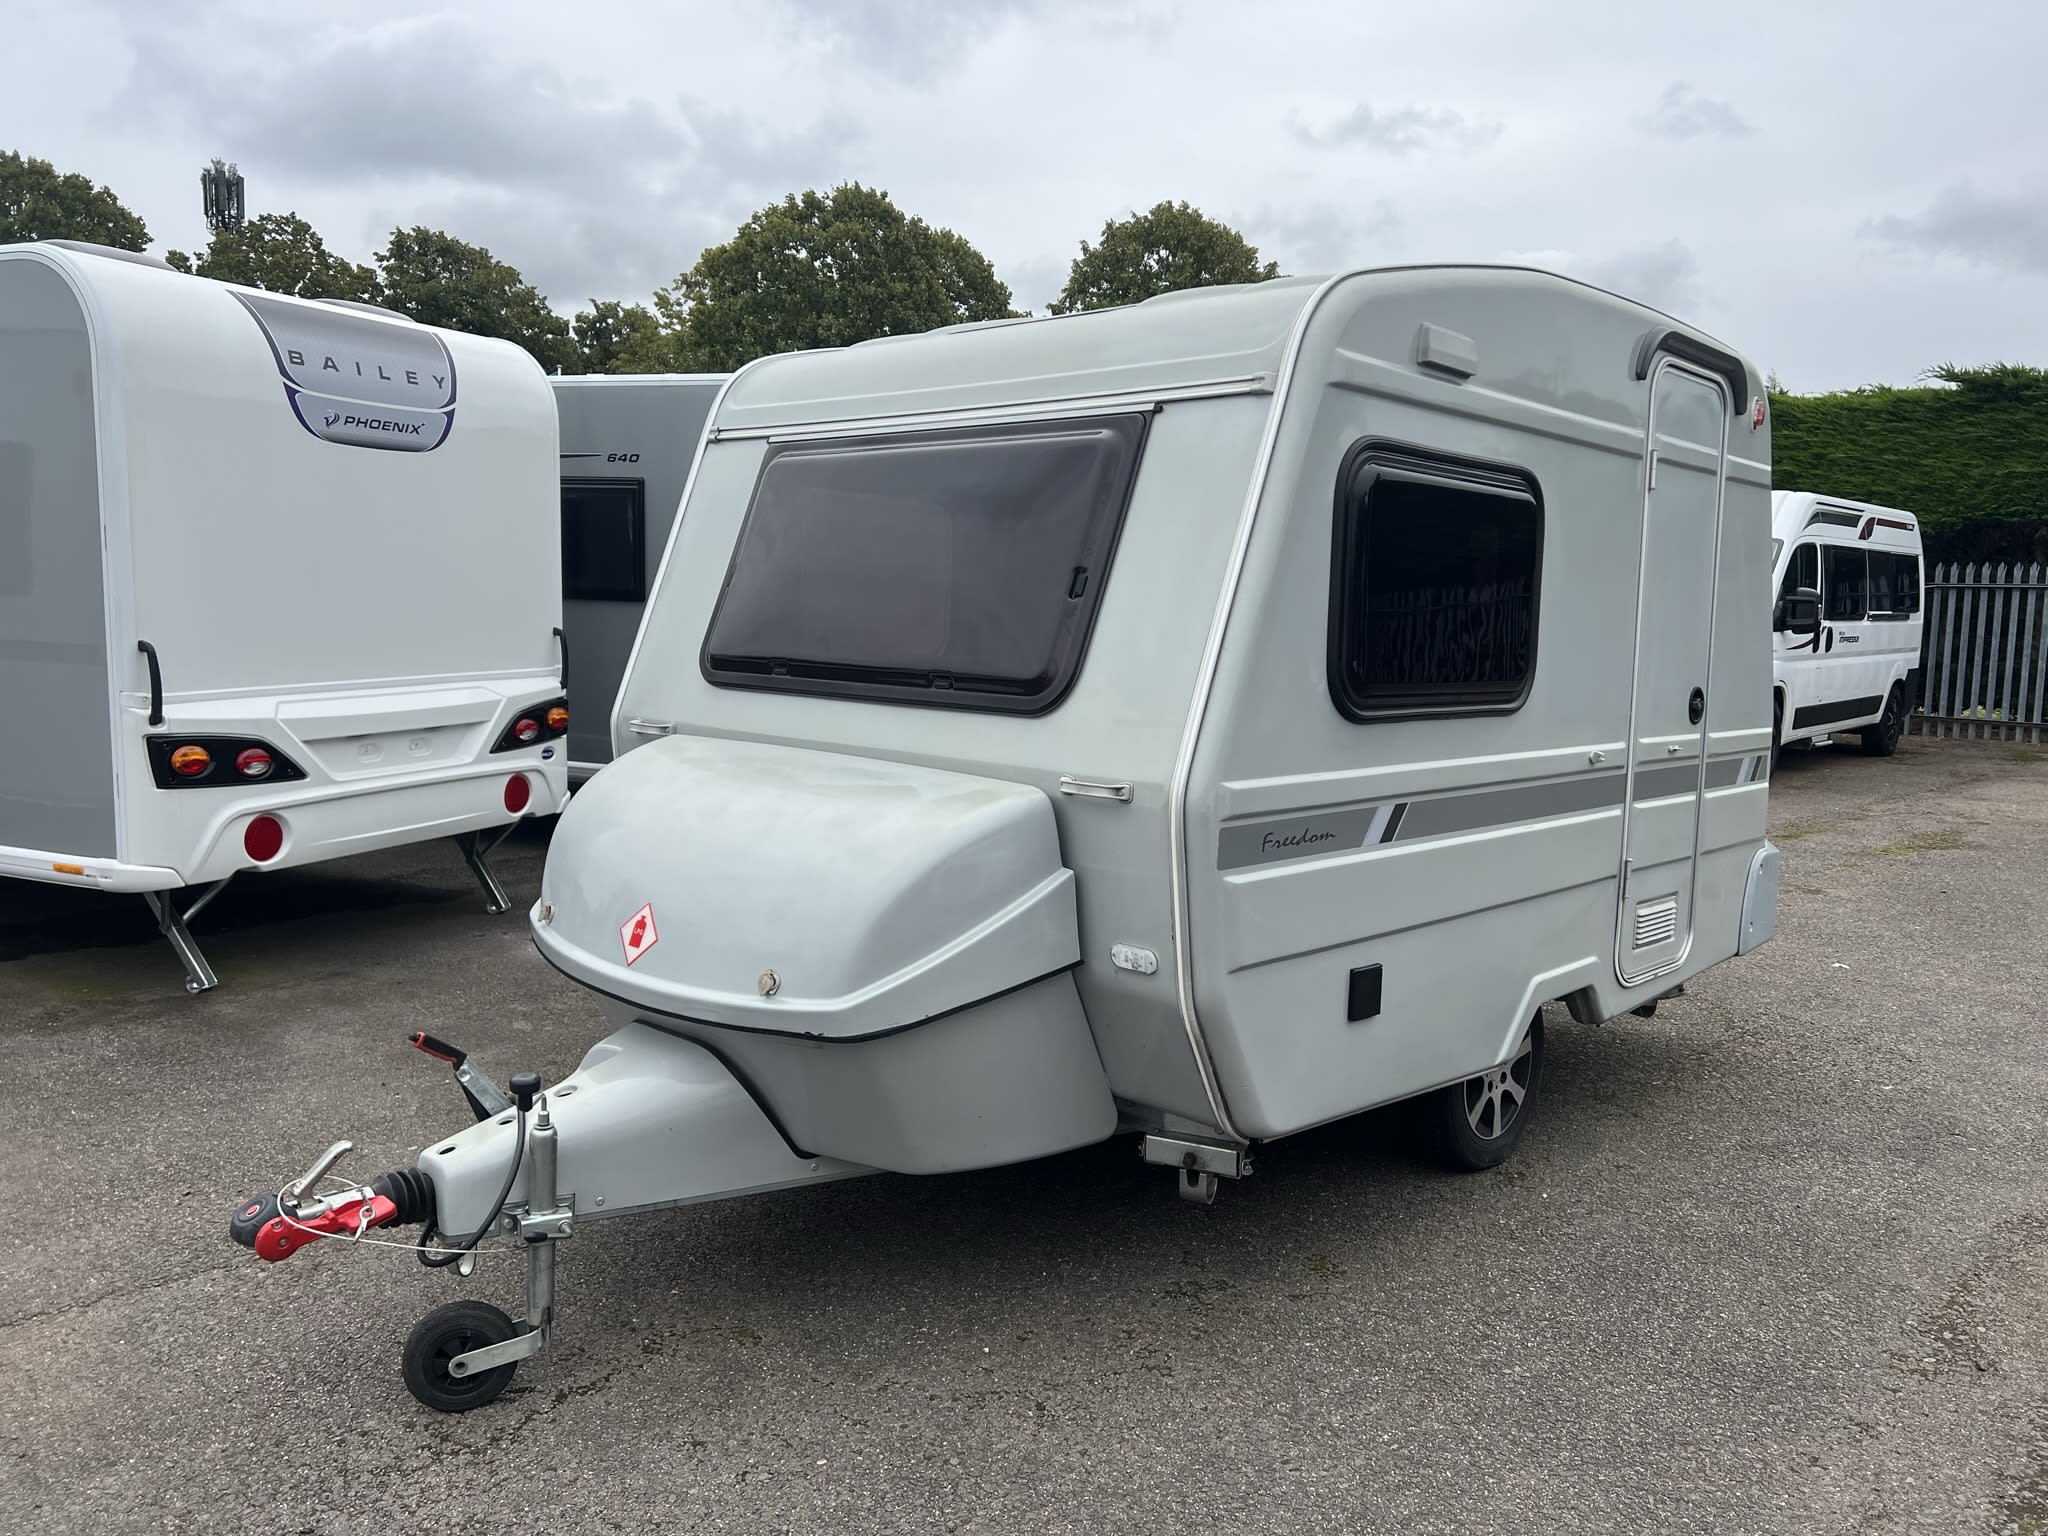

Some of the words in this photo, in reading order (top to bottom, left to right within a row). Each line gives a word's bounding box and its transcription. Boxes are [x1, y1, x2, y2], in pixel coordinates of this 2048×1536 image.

[287, 350, 445, 389] BAILEY
[607, 453, 640, 463] 640
[1262, 827, 1336, 852] Freedom
